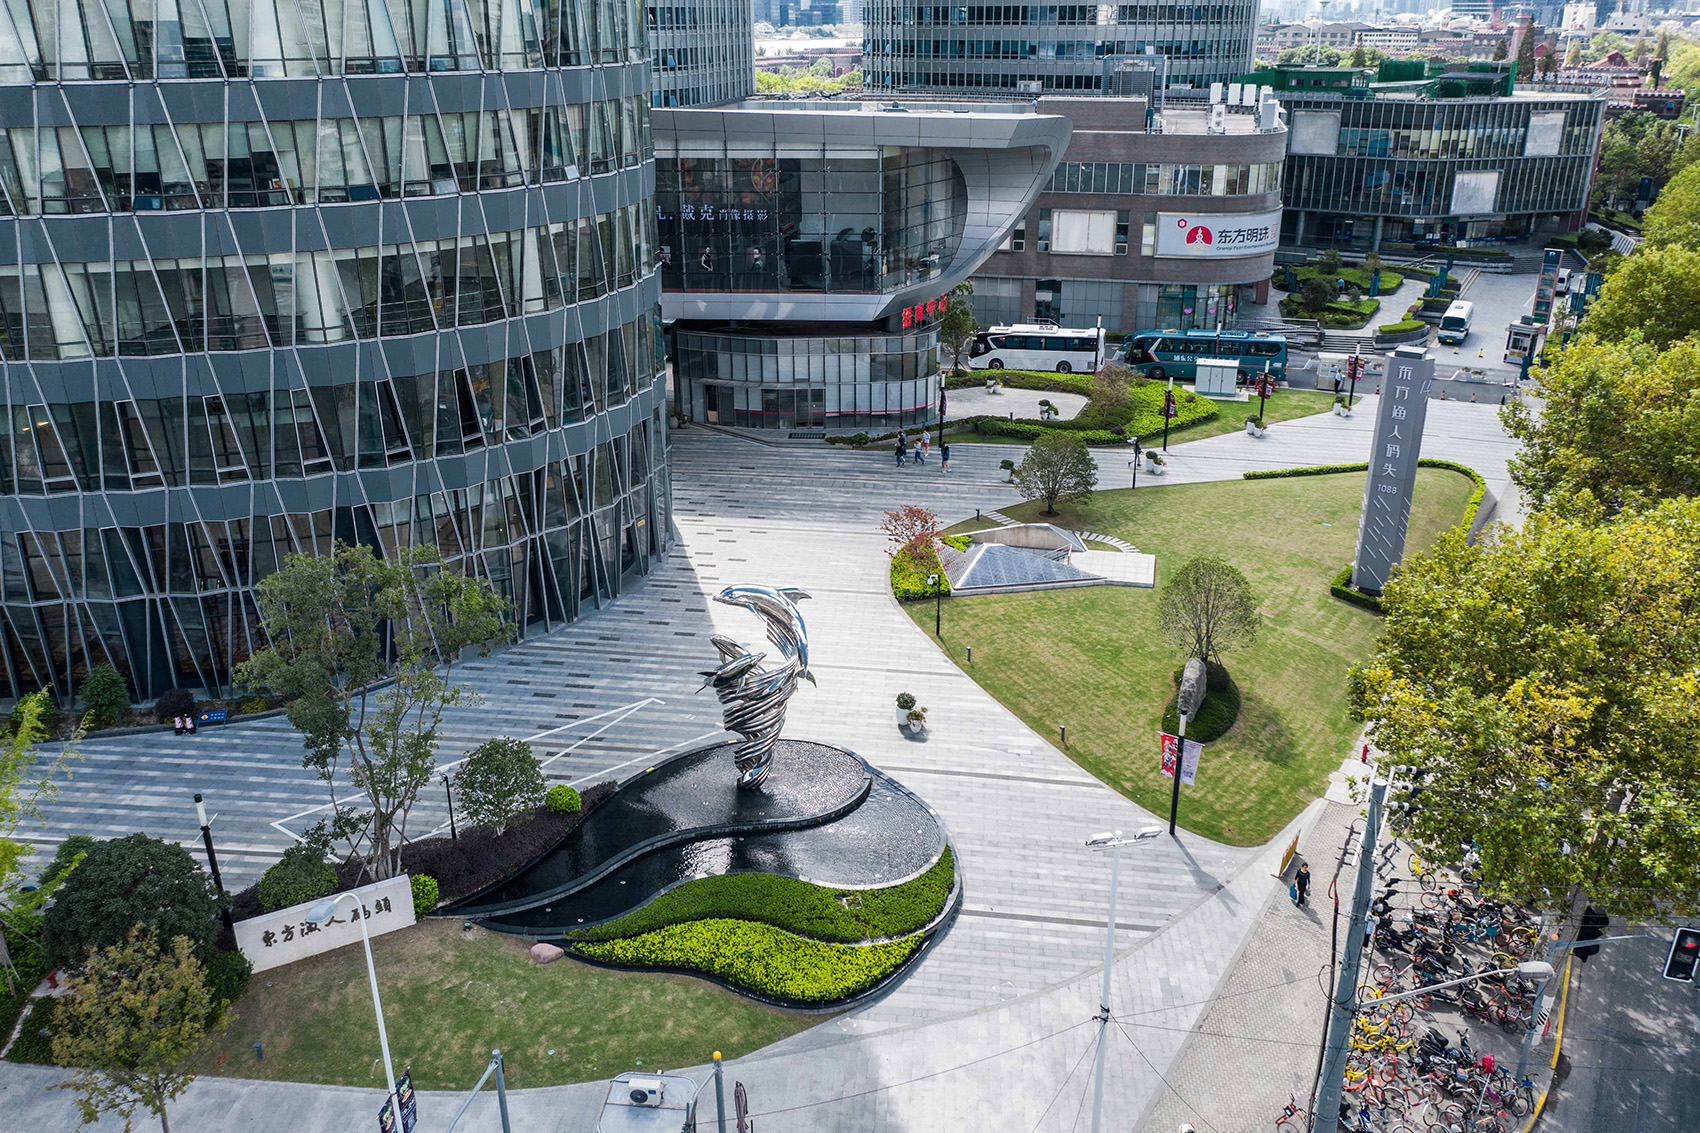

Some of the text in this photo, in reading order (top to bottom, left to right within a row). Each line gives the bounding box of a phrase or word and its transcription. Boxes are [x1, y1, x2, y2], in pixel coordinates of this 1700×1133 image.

[1217, 226, 1269, 244] 东方明珠
[902, 294, 948, 329] 招商中心
[1382, 365, 1413, 478] 东方渔人码头
[1377, 484, 1398, 495] 1088
